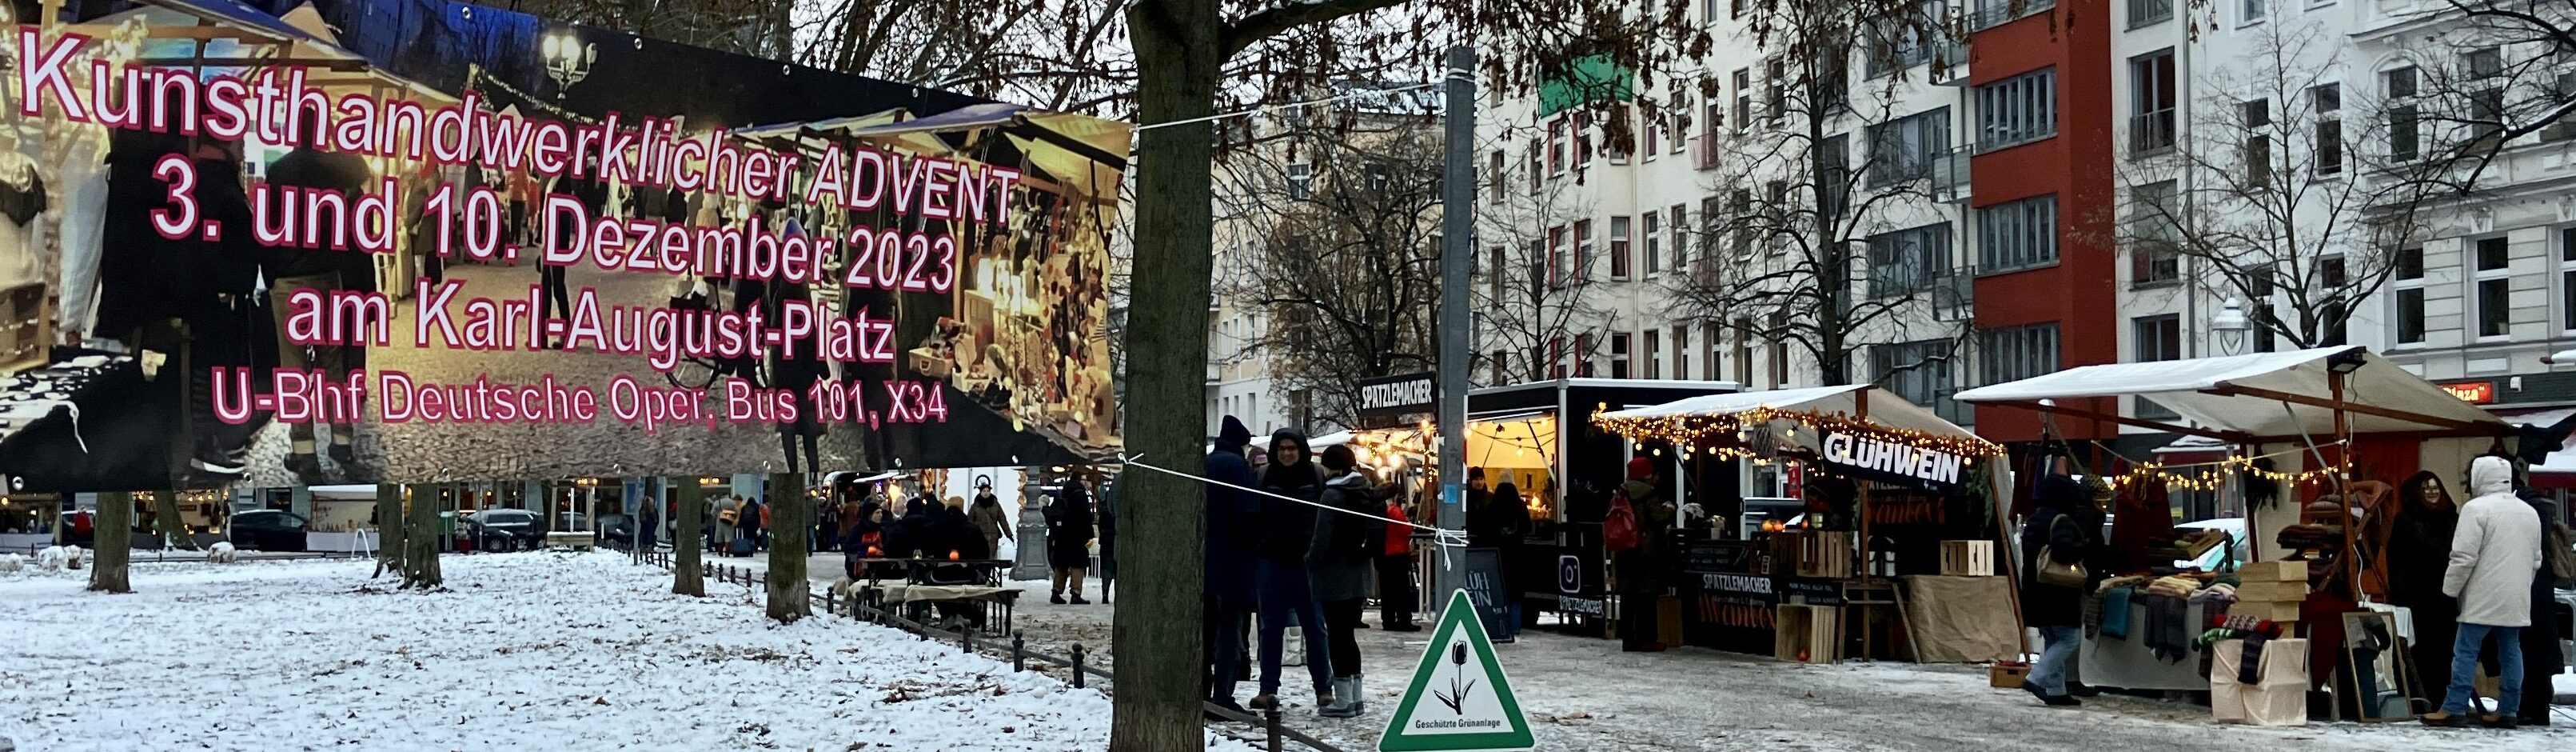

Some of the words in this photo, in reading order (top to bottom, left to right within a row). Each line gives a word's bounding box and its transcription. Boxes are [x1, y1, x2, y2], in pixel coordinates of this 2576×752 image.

[19, 26, 798, 201] Kunsthandwerklicher
[807, 143, 1020, 226] ADVENT
[151, 154, 221, 240] 3.
[253, 178, 400, 254] und
[425, 182, 519, 262] 10.
[544, 194, 831, 284] Dezember
[846, 226, 957, 293] 2023
[285, 289, 389, 346] am
[416, 277, 895, 372] Karl-August-Platz
[213, 367, 365, 423] U-Bhf
[380, 370, 595, 423] Deutsche
[727, 378, 798, 423] Bus
[884, 381, 947, 423] X34
[1824, 432, 1960, 484] GLÜHWEIN
[1415, 719, 1457, 729] Geschützte
[1458, 718, 1501, 728] Grünanlage
